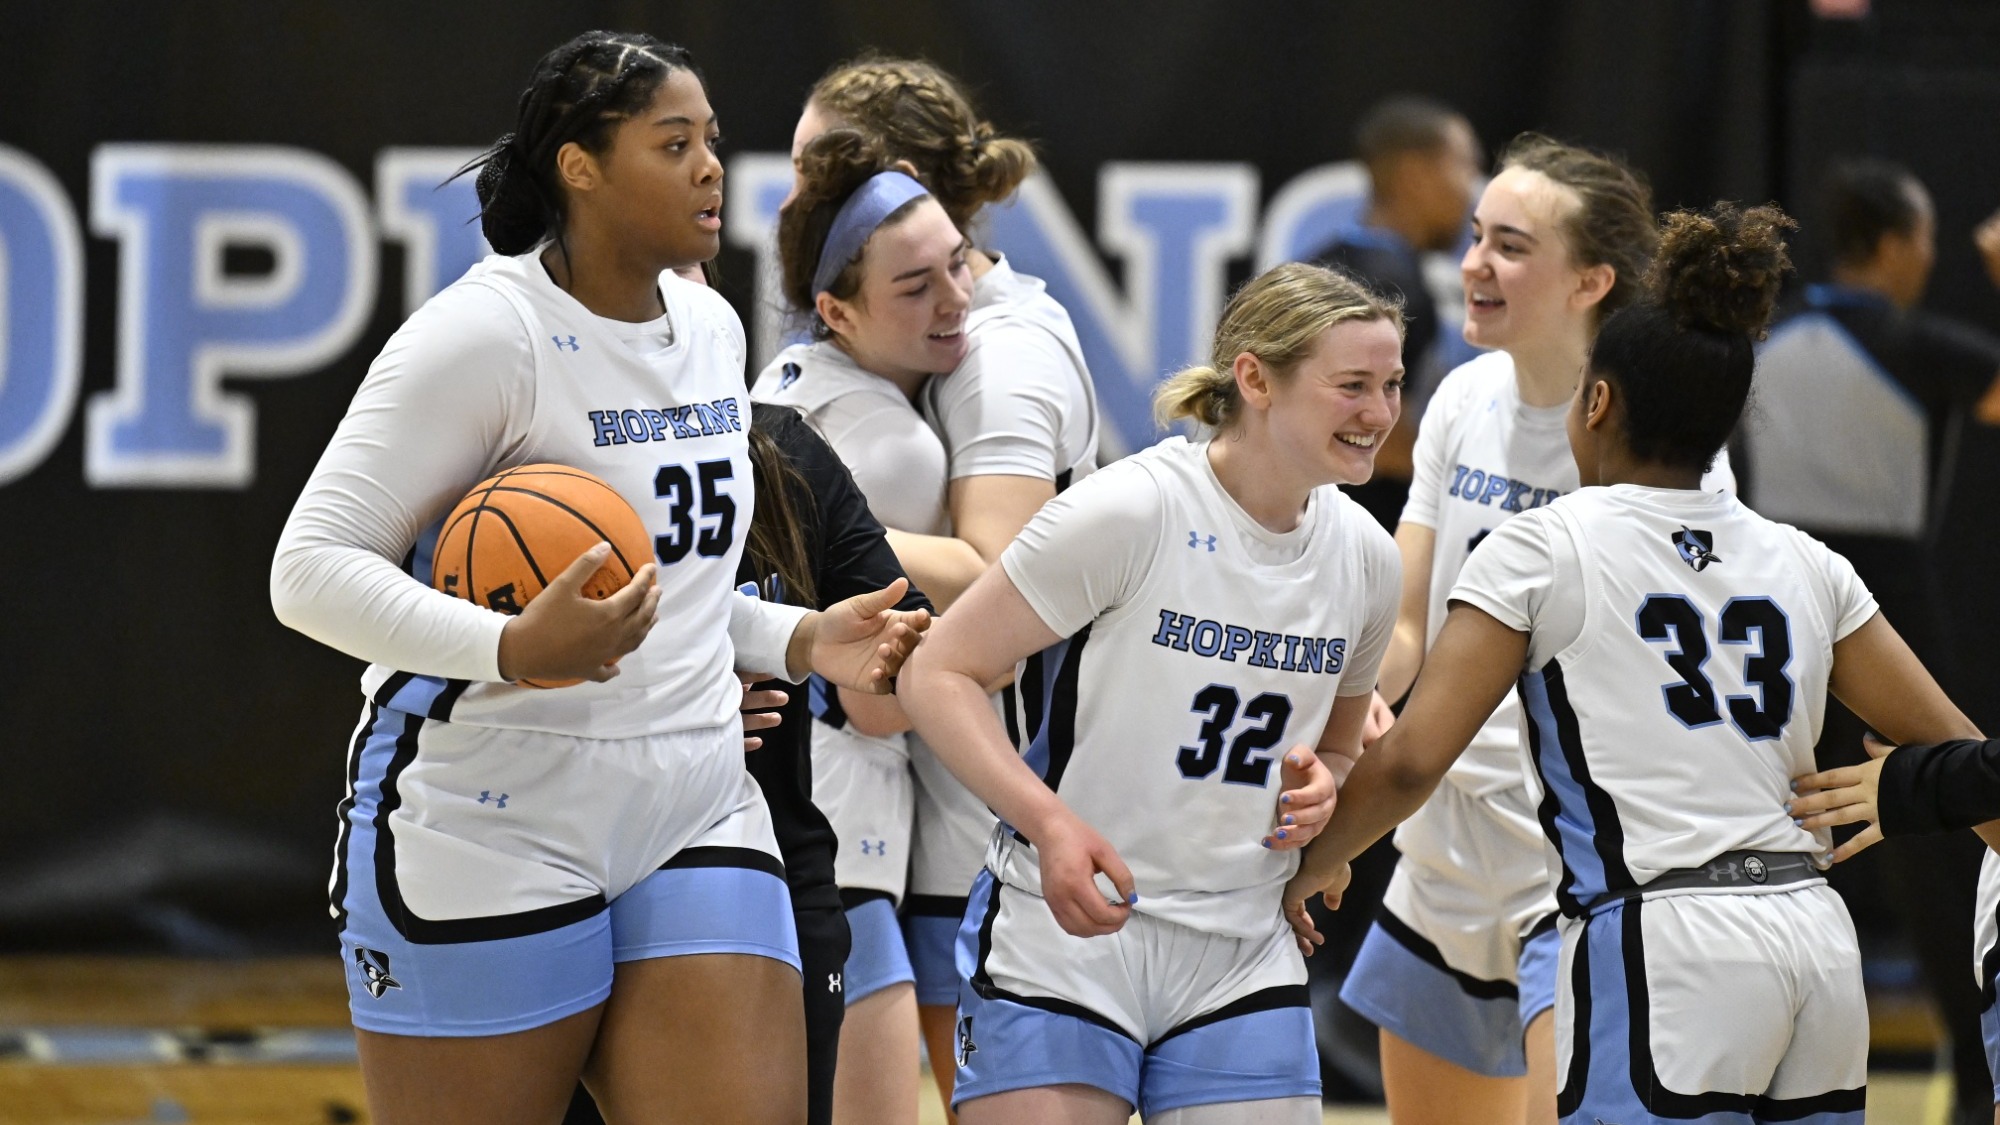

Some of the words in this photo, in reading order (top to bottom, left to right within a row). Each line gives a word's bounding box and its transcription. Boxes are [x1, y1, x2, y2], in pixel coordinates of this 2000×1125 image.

[588, 397, 741, 447] HOPKINS
[653, 457, 737, 567] 35
[1449, 464, 1572, 514] OPKI
[1152, 609, 1347, 674] HOPKINS
[1635, 593, 1796, 743] 33
[1175, 683, 1294, 789] 32
